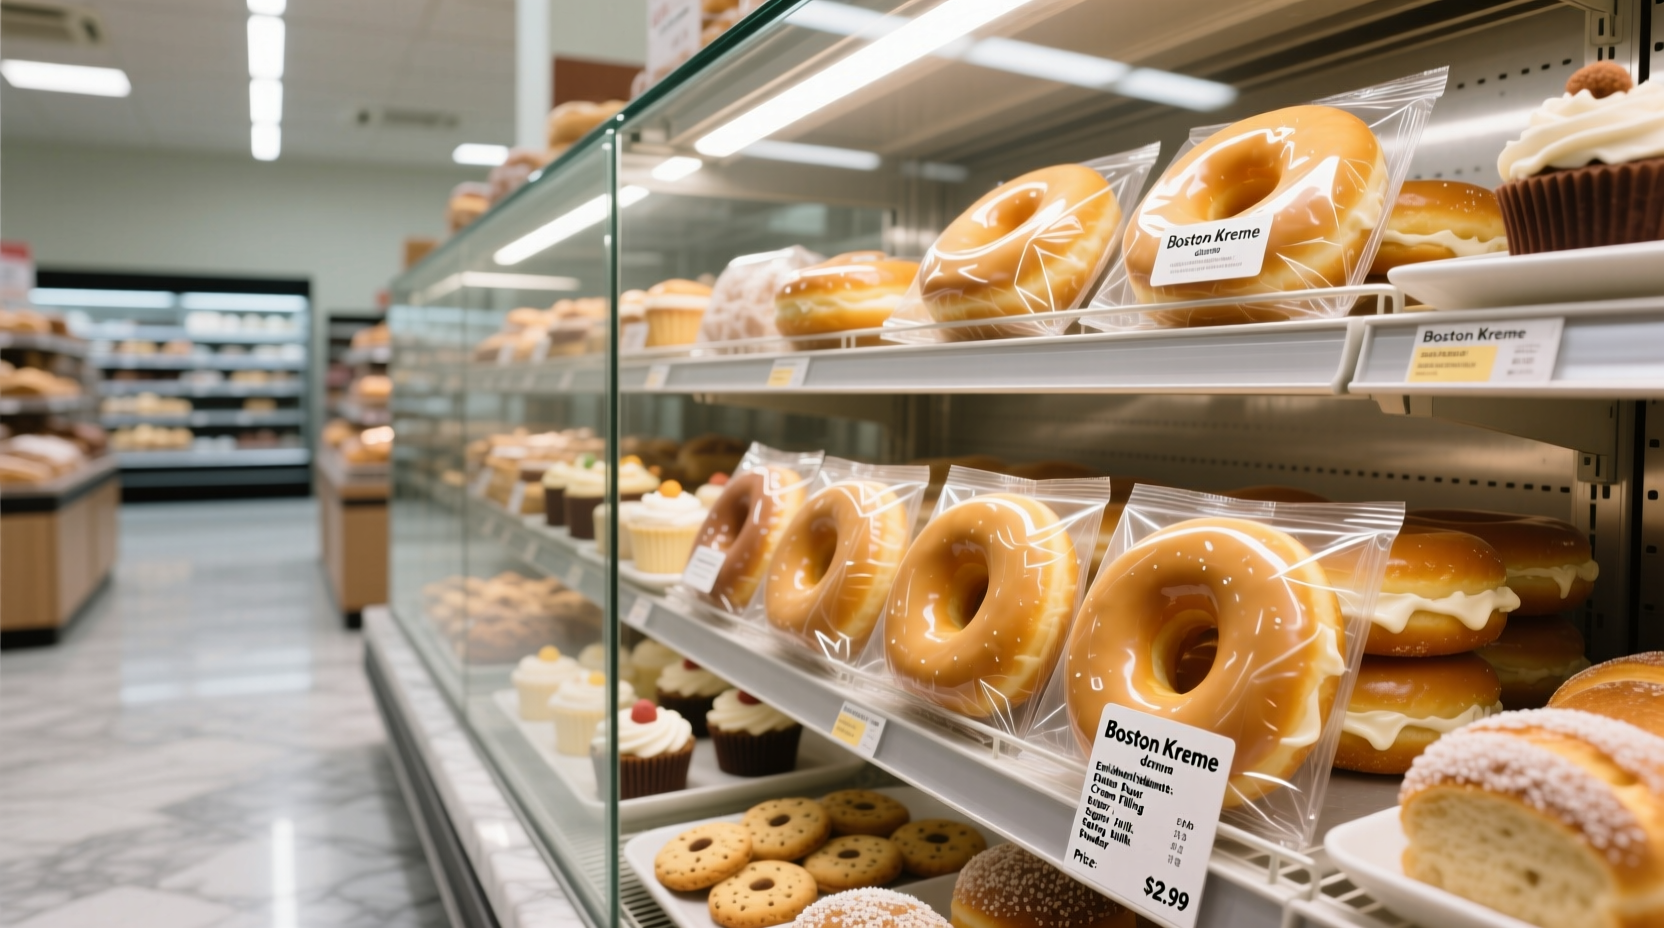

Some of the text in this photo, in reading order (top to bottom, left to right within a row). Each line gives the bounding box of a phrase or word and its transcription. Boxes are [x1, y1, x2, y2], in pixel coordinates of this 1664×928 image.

[1167, 227, 1260, 249] Boston Kreme
[1423, 327, 1526, 343] Boston Kreme
[1105, 719, 1160, 753] Boston
[1162, 737, 1219, 772] Kreme
[1143, 875, 1190, 911] $2.99
